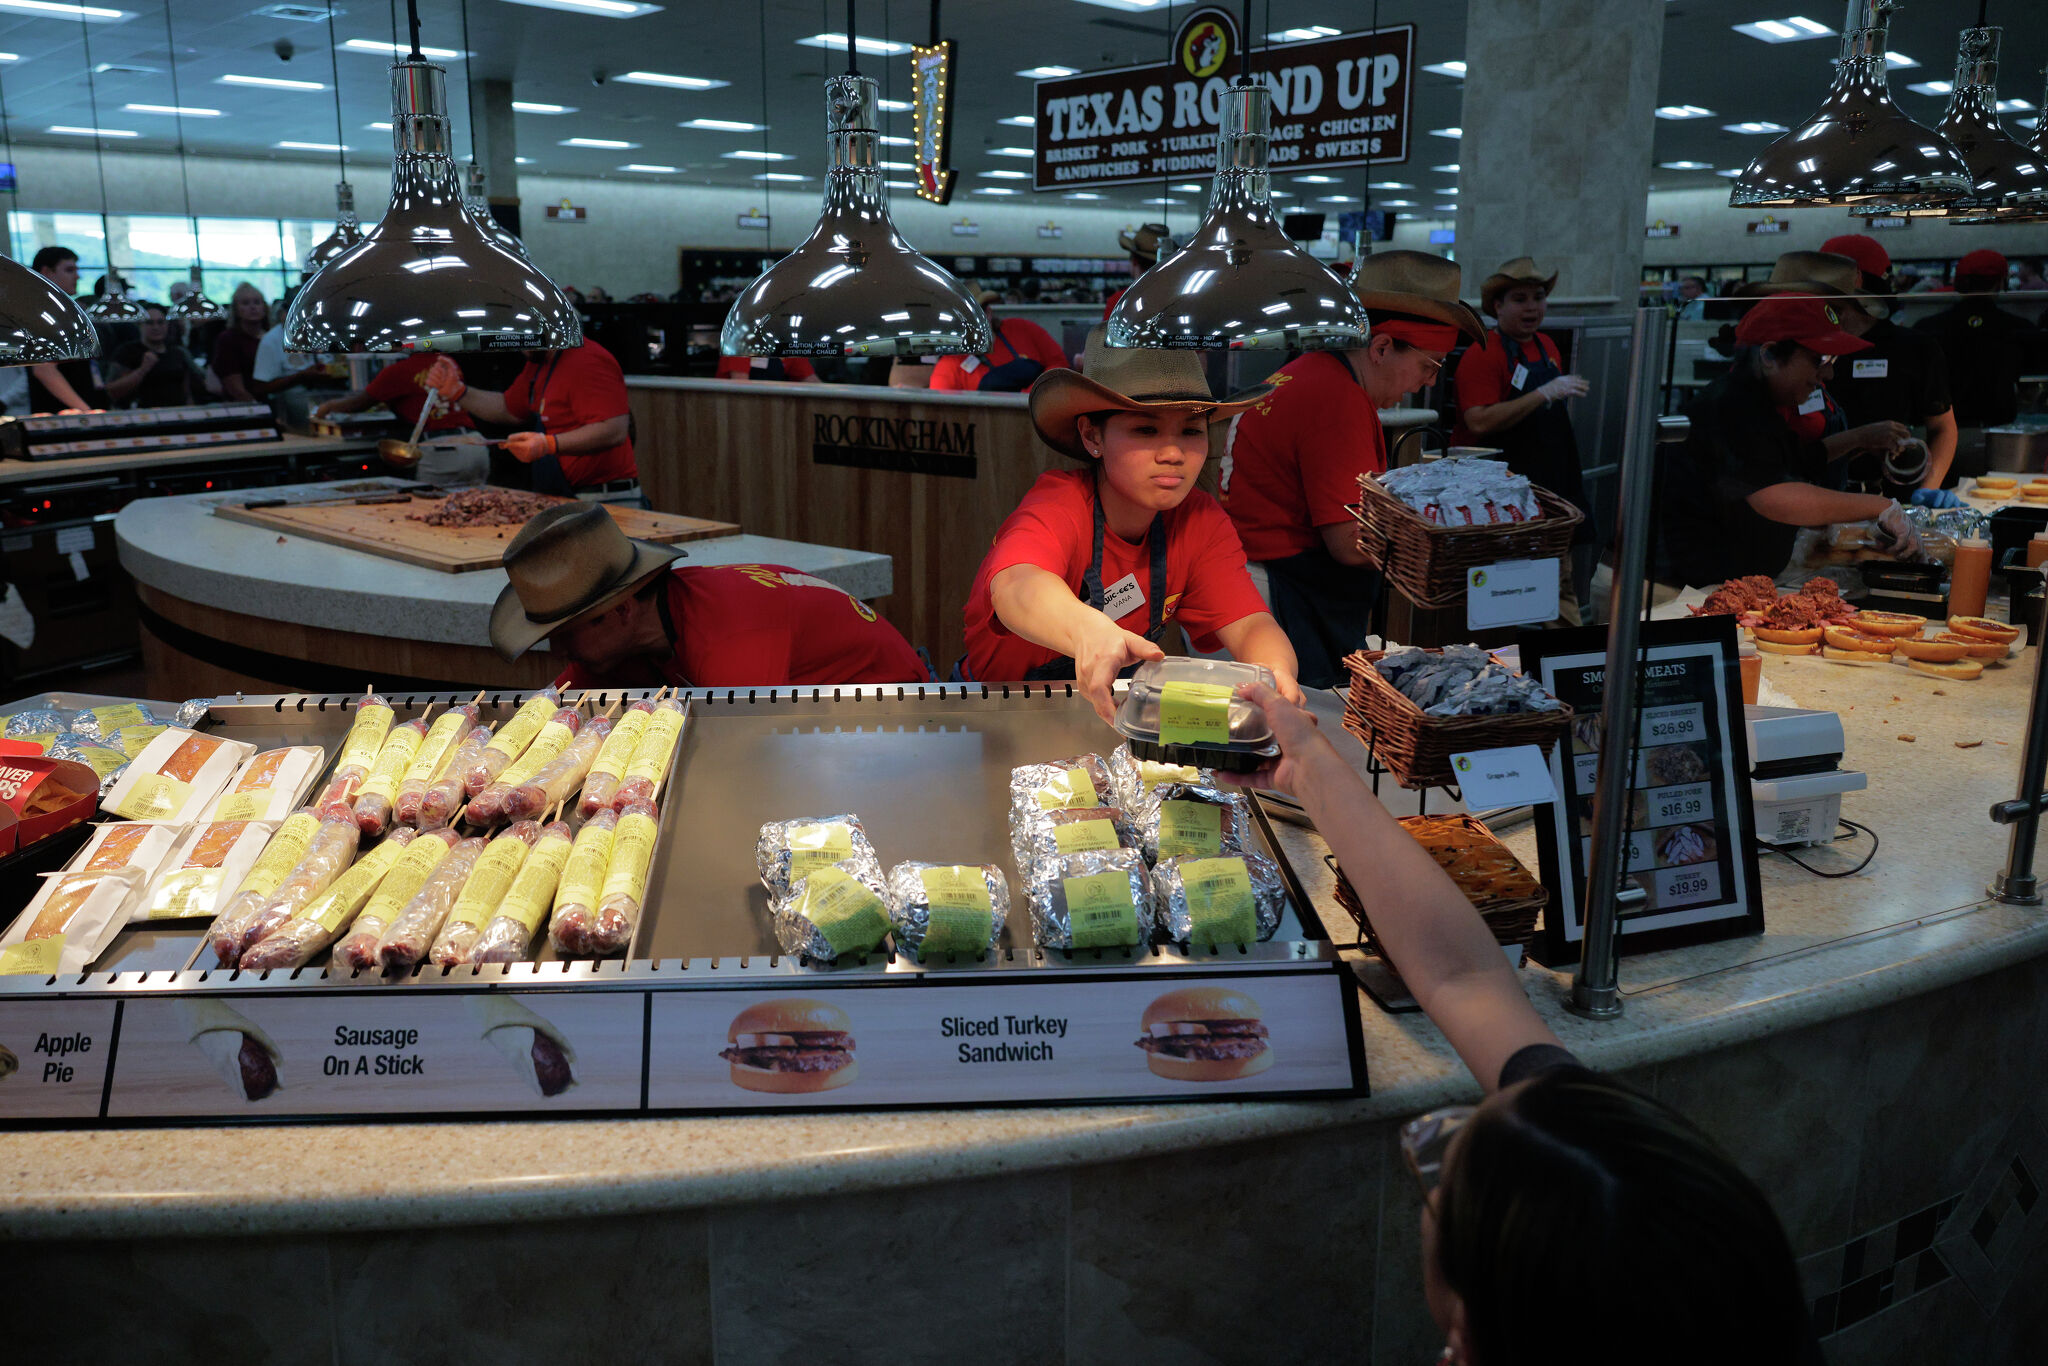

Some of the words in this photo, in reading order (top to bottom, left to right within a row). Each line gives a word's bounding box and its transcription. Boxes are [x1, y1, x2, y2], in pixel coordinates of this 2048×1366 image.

[1045, 84, 1164, 142] TEXAS
[1172, 64, 1324, 129] ROND
[1336, 53, 1400, 111] UP
[1045, 144, 1099, 164] BRISKET
[1111, 140, 1149, 158] PORK
[1320, 114, 1397, 137] CHICKEN
[1054, 160, 1141, 181] SANDWICHES
[1314, 137, 1382, 159] SWEETS
[813, 413, 977, 456] ROCKINGHAM
[1112, 594, 1133, 608] VANA
[1645, 663, 1687, 679] MEATS
[1652, 720, 1694, 737] $26.99
[1657, 789, 1683, 800] PULLED
[1661, 800, 1701, 817] $16.99
[1669, 879, 1708, 896] $19.99
[334, 1025, 419, 1050] Sausage
[941, 1016, 999, 1038] Sliced
[1003, 1015, 1068, 1039] Turkey
[34, 1032, 92, 1057] Apple
[958, 1041, 1054, 1063] Sandwich
[43, 1062, 74, 1083] Pie
[323, 1055, 350, 1075] On
[354, 1055, 369, 1075] A
[374, 1054, 425, 1075] Stick
